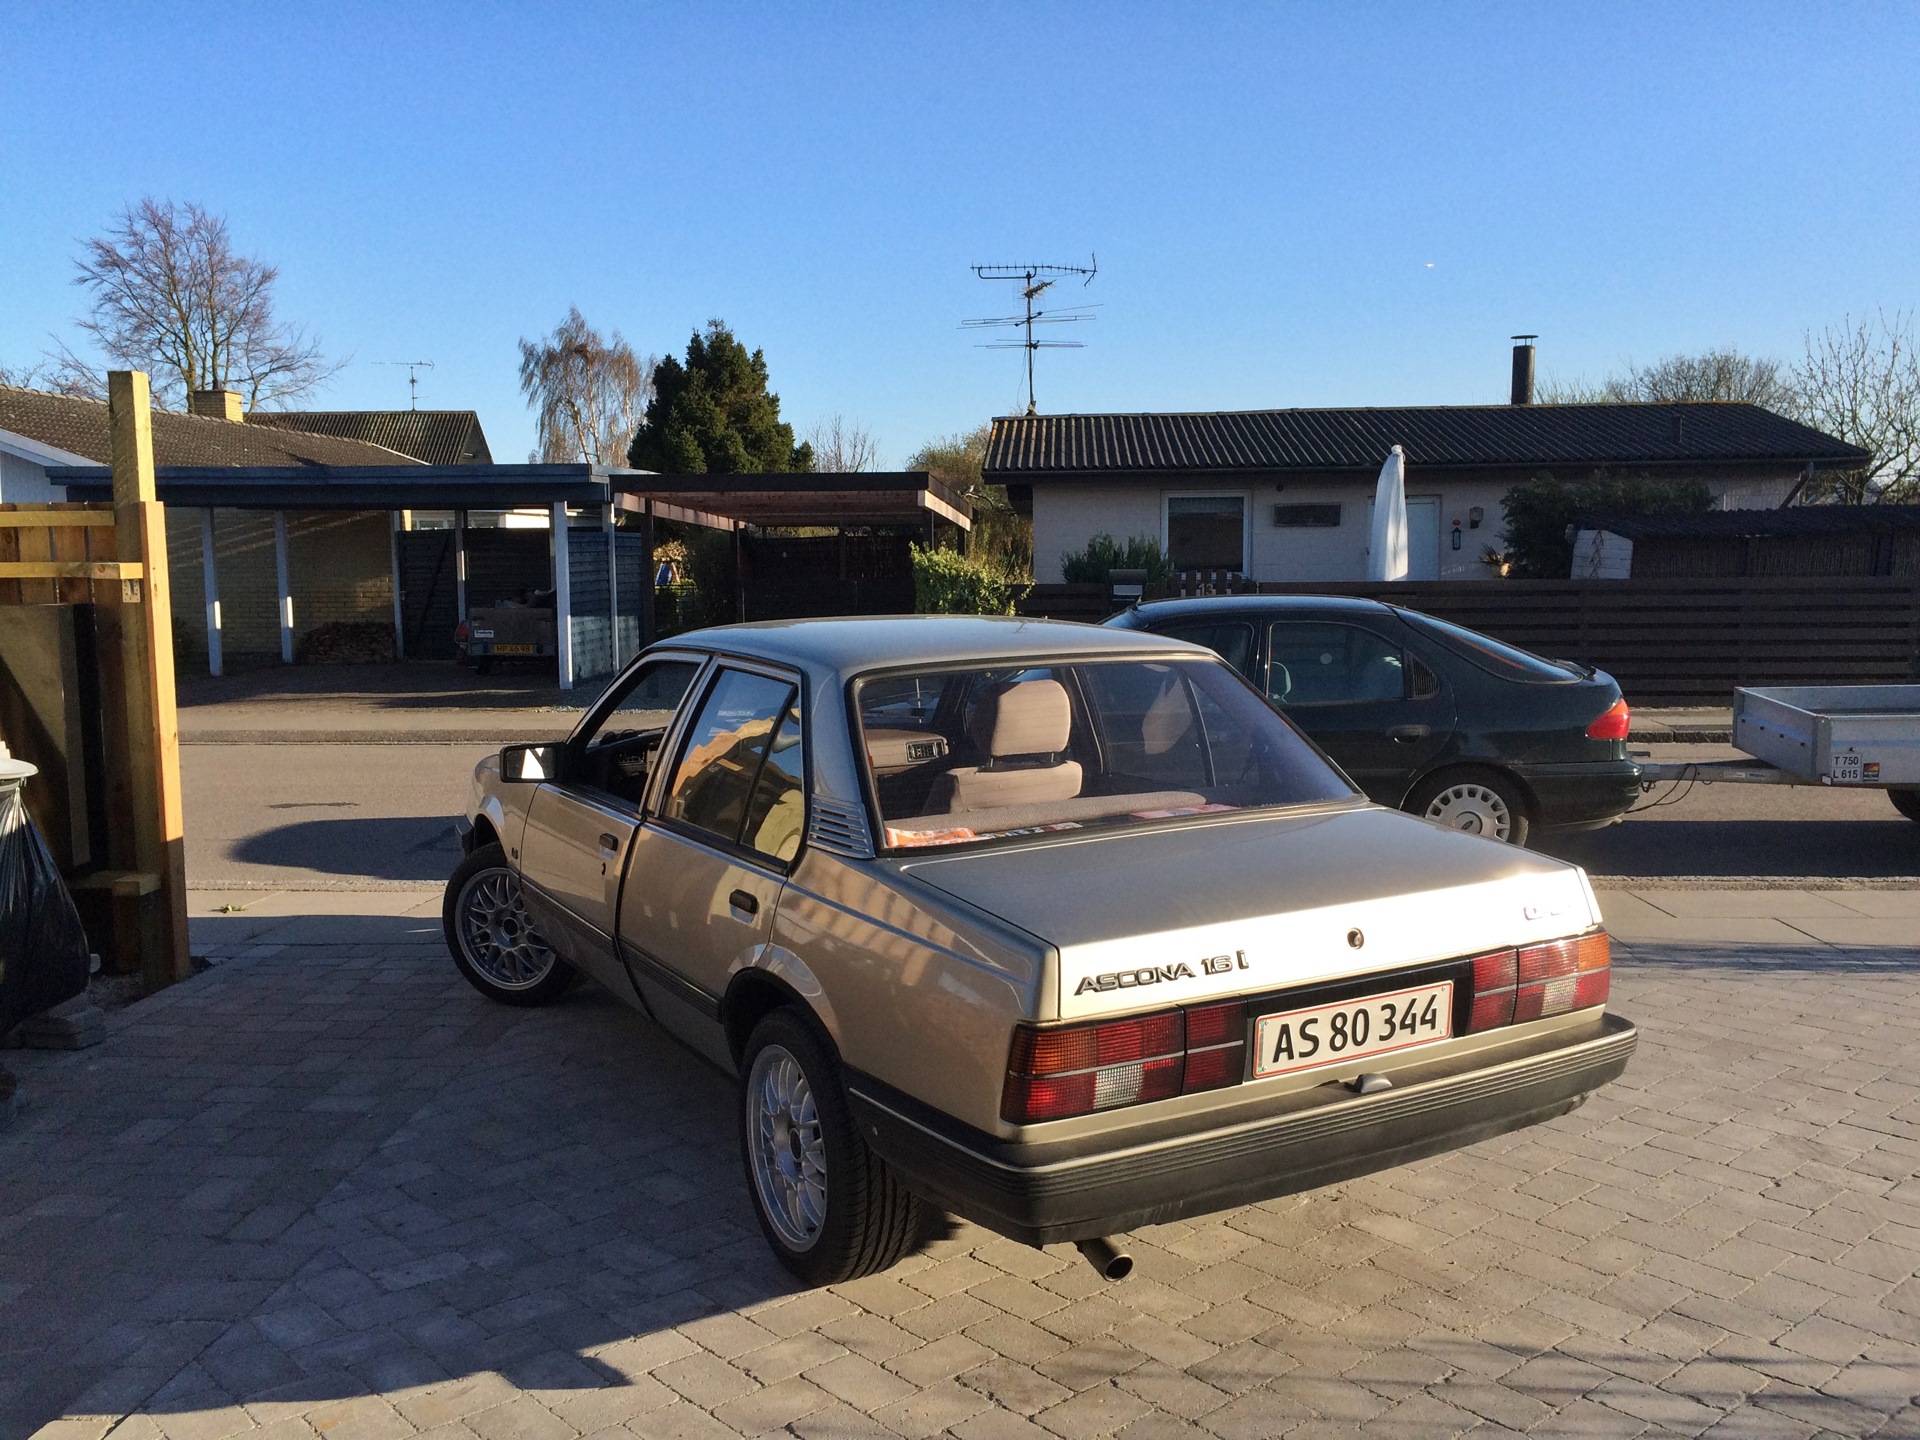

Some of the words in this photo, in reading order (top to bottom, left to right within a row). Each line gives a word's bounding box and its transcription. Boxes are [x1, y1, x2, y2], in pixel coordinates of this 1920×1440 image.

[1199, 583, 1214, 596] 13
[1834, 756, 1840, 765] T
[1843, 756, 1859, 765] 750
[1833, 770, 1838, 778] L
[1842, 770, 1858, 778] 615
[1074, 962, 1196, 996] ASCONA
[1272, 1017, 1320, 1063] AS
[1329, 1008, 1370, 1052] 80
[1378, 993, 1438, 1042] 344
